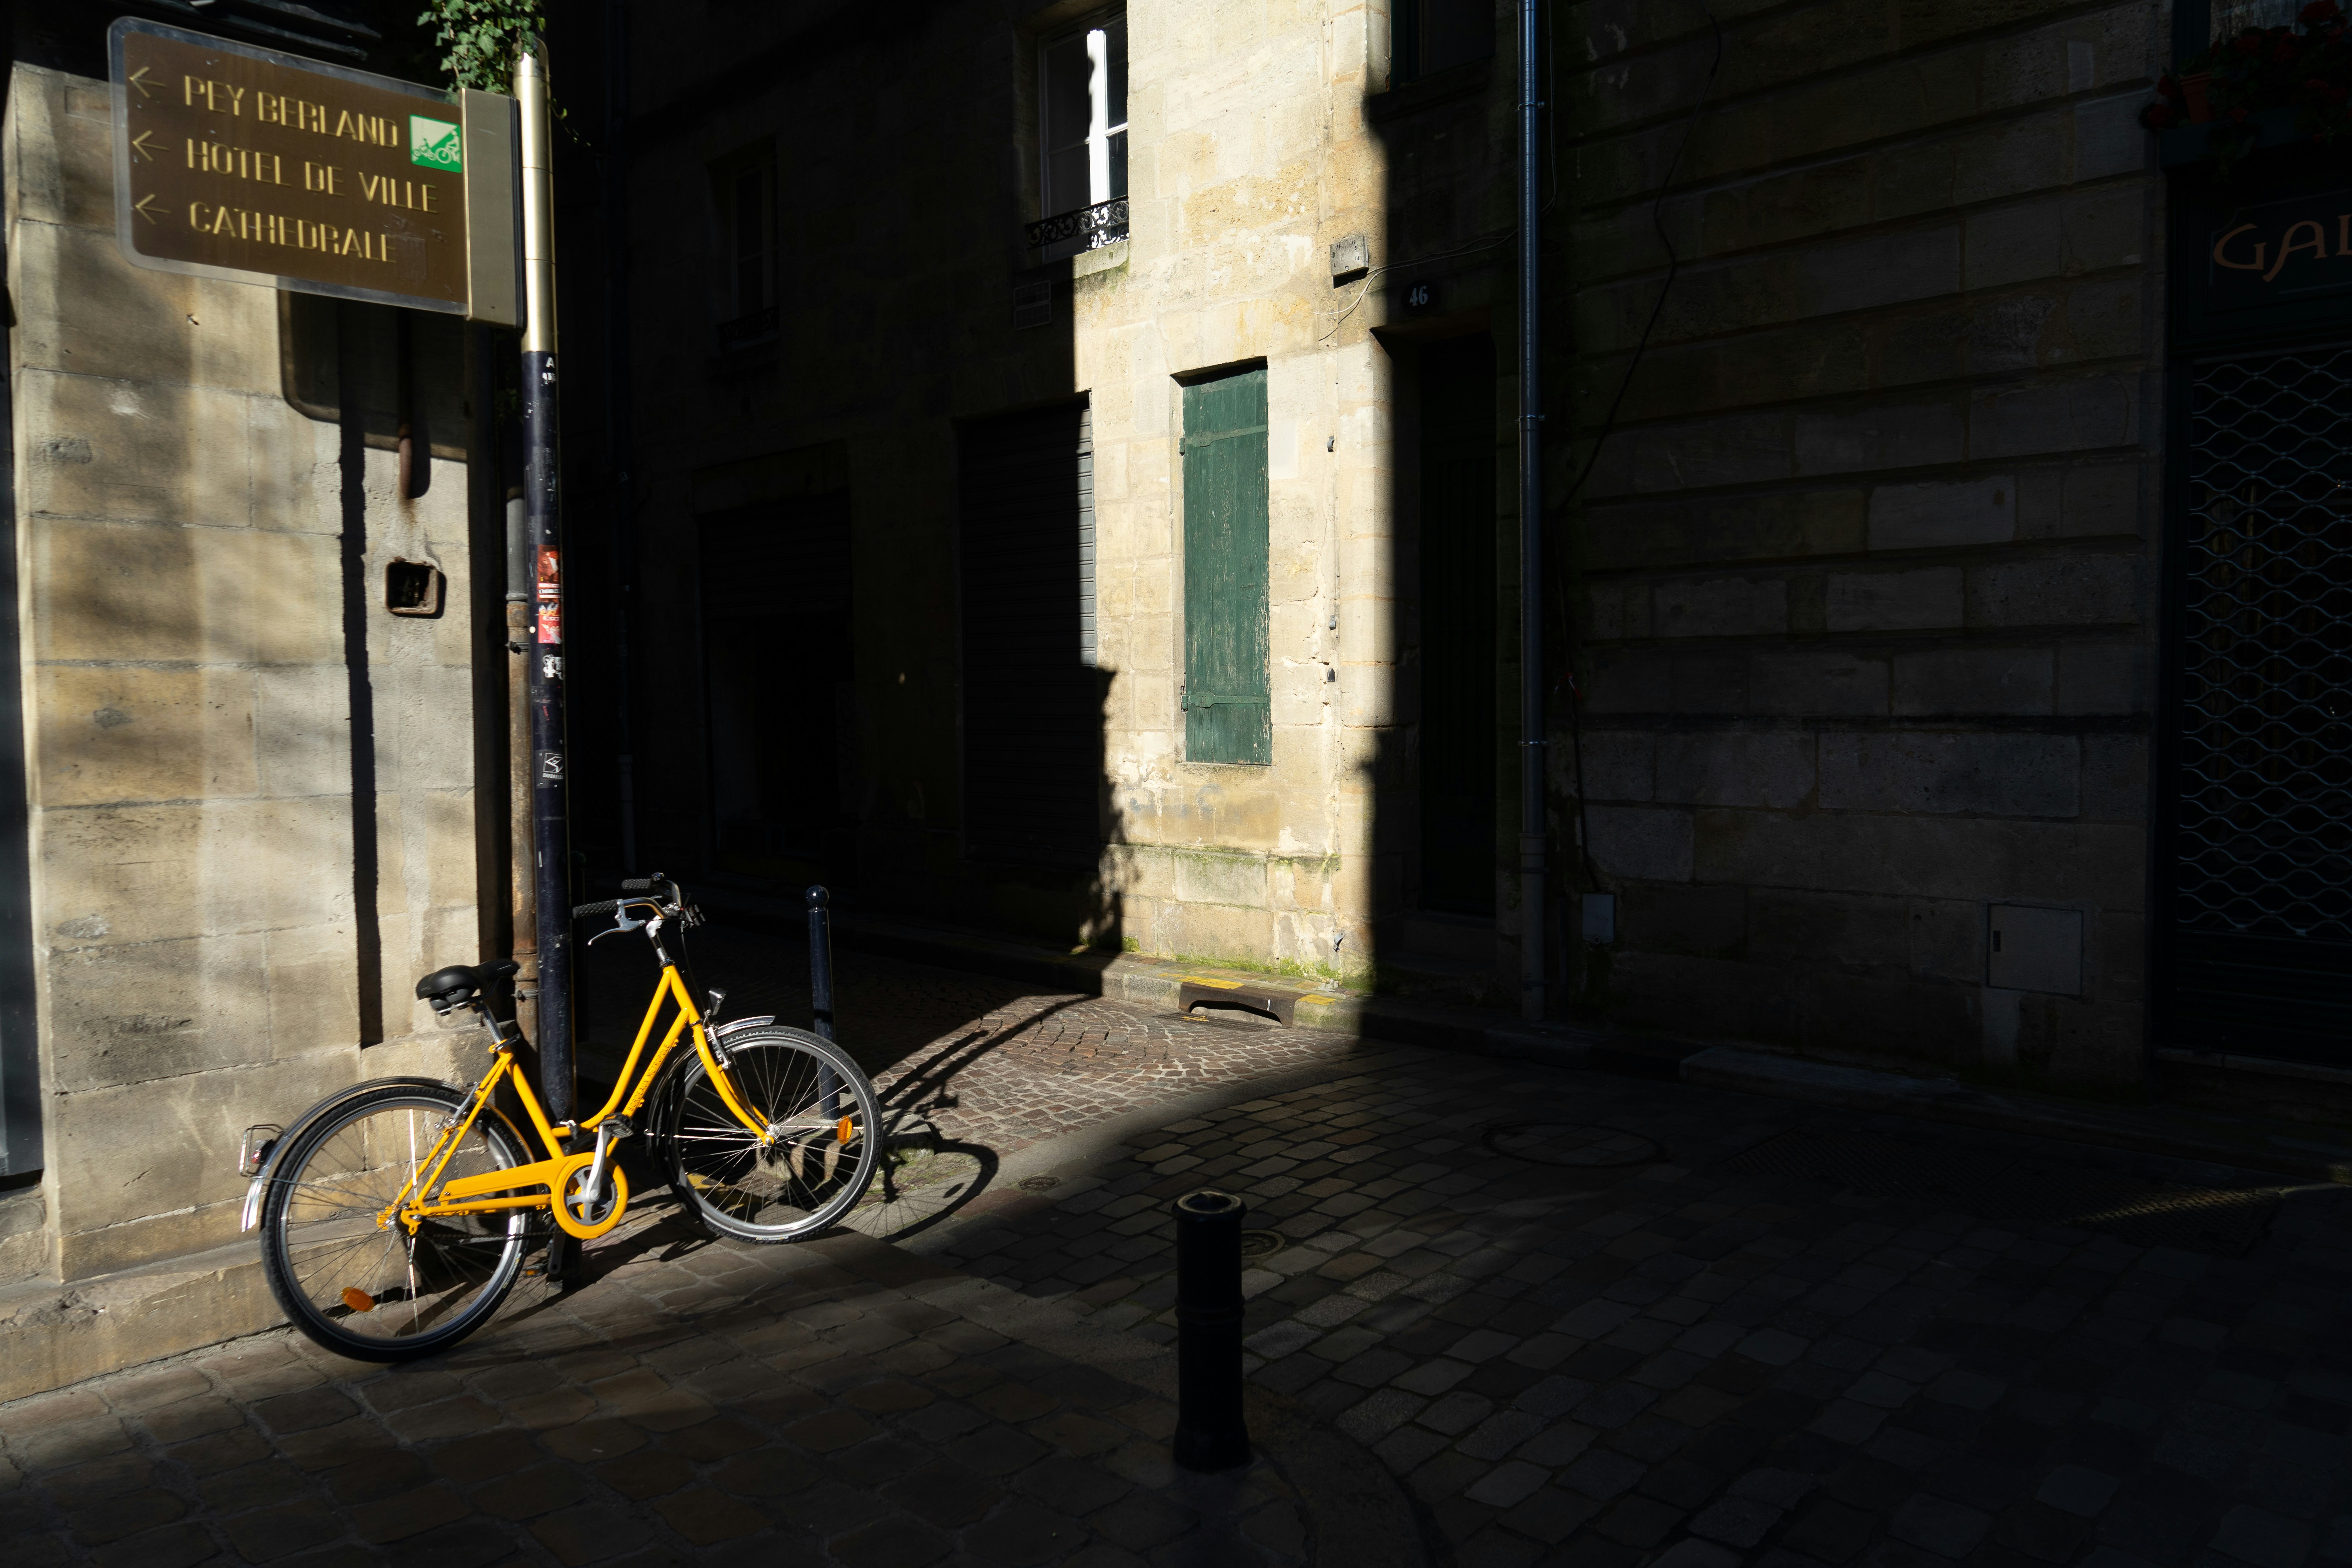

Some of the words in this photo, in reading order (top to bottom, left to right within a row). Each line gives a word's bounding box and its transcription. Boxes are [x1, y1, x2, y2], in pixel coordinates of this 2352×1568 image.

[184, 74, 245, 116] PEY
[257, 91, 399, 149] BERLAND
[305, 161, 345, 197] DE
[359, 171, 439, 214] VILLE
[190, 201, 397, 263] CATHEDRALE
[1409, 285, 1428, 307] 46
